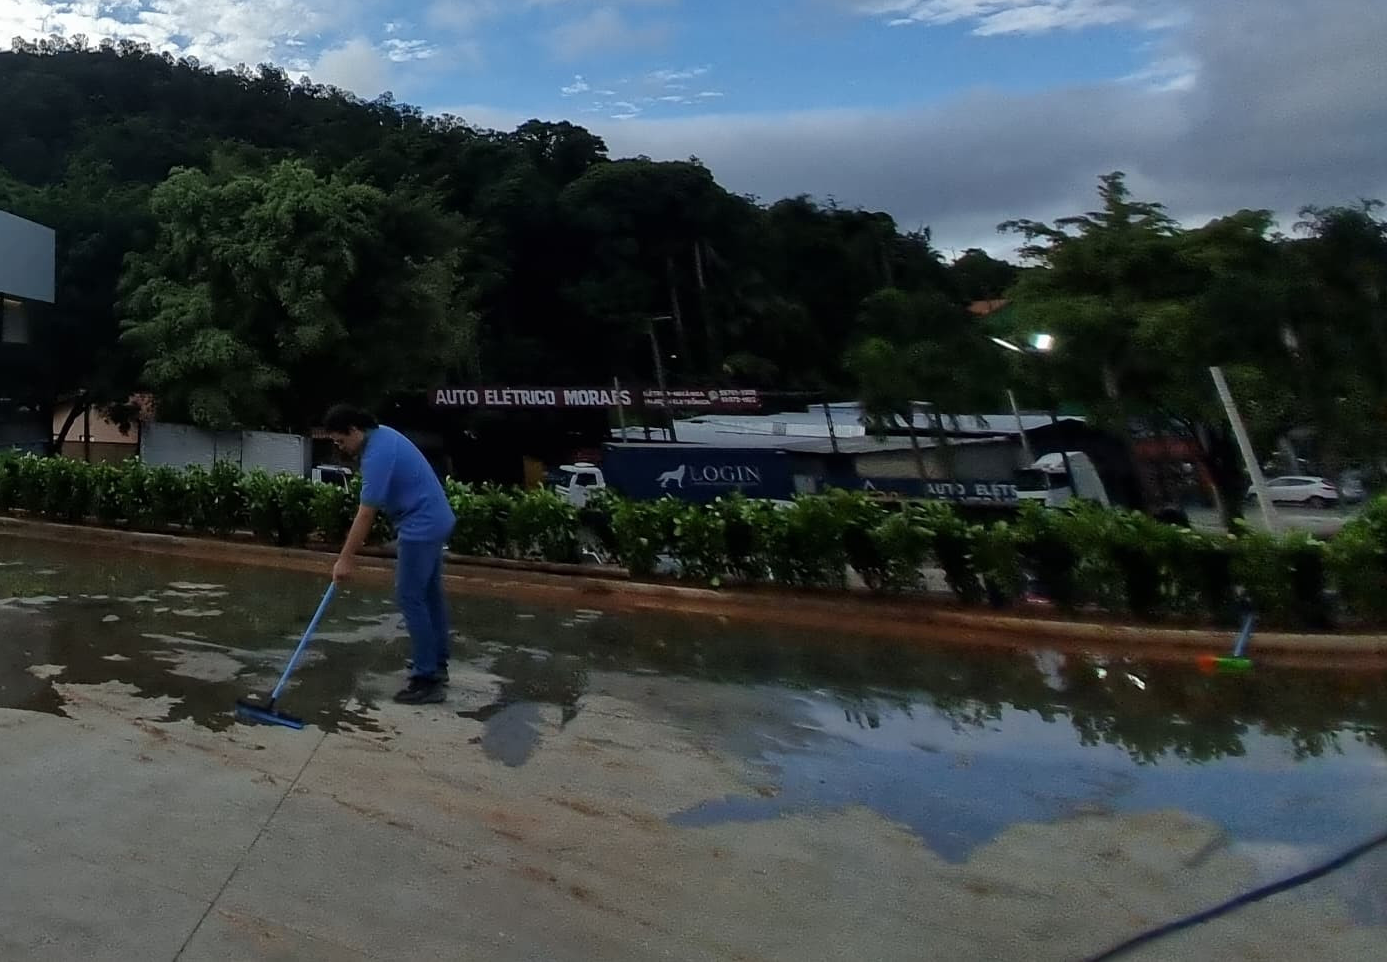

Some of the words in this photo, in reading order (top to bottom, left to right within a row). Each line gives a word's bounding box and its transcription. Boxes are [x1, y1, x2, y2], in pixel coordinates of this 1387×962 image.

[436, 390, 479, 405] AUTO
[485, 387, 555, 405] ELÉTRICO
[564, 390, 631, 405] MORAES
[688, 465, 762, 482] LOGIN
